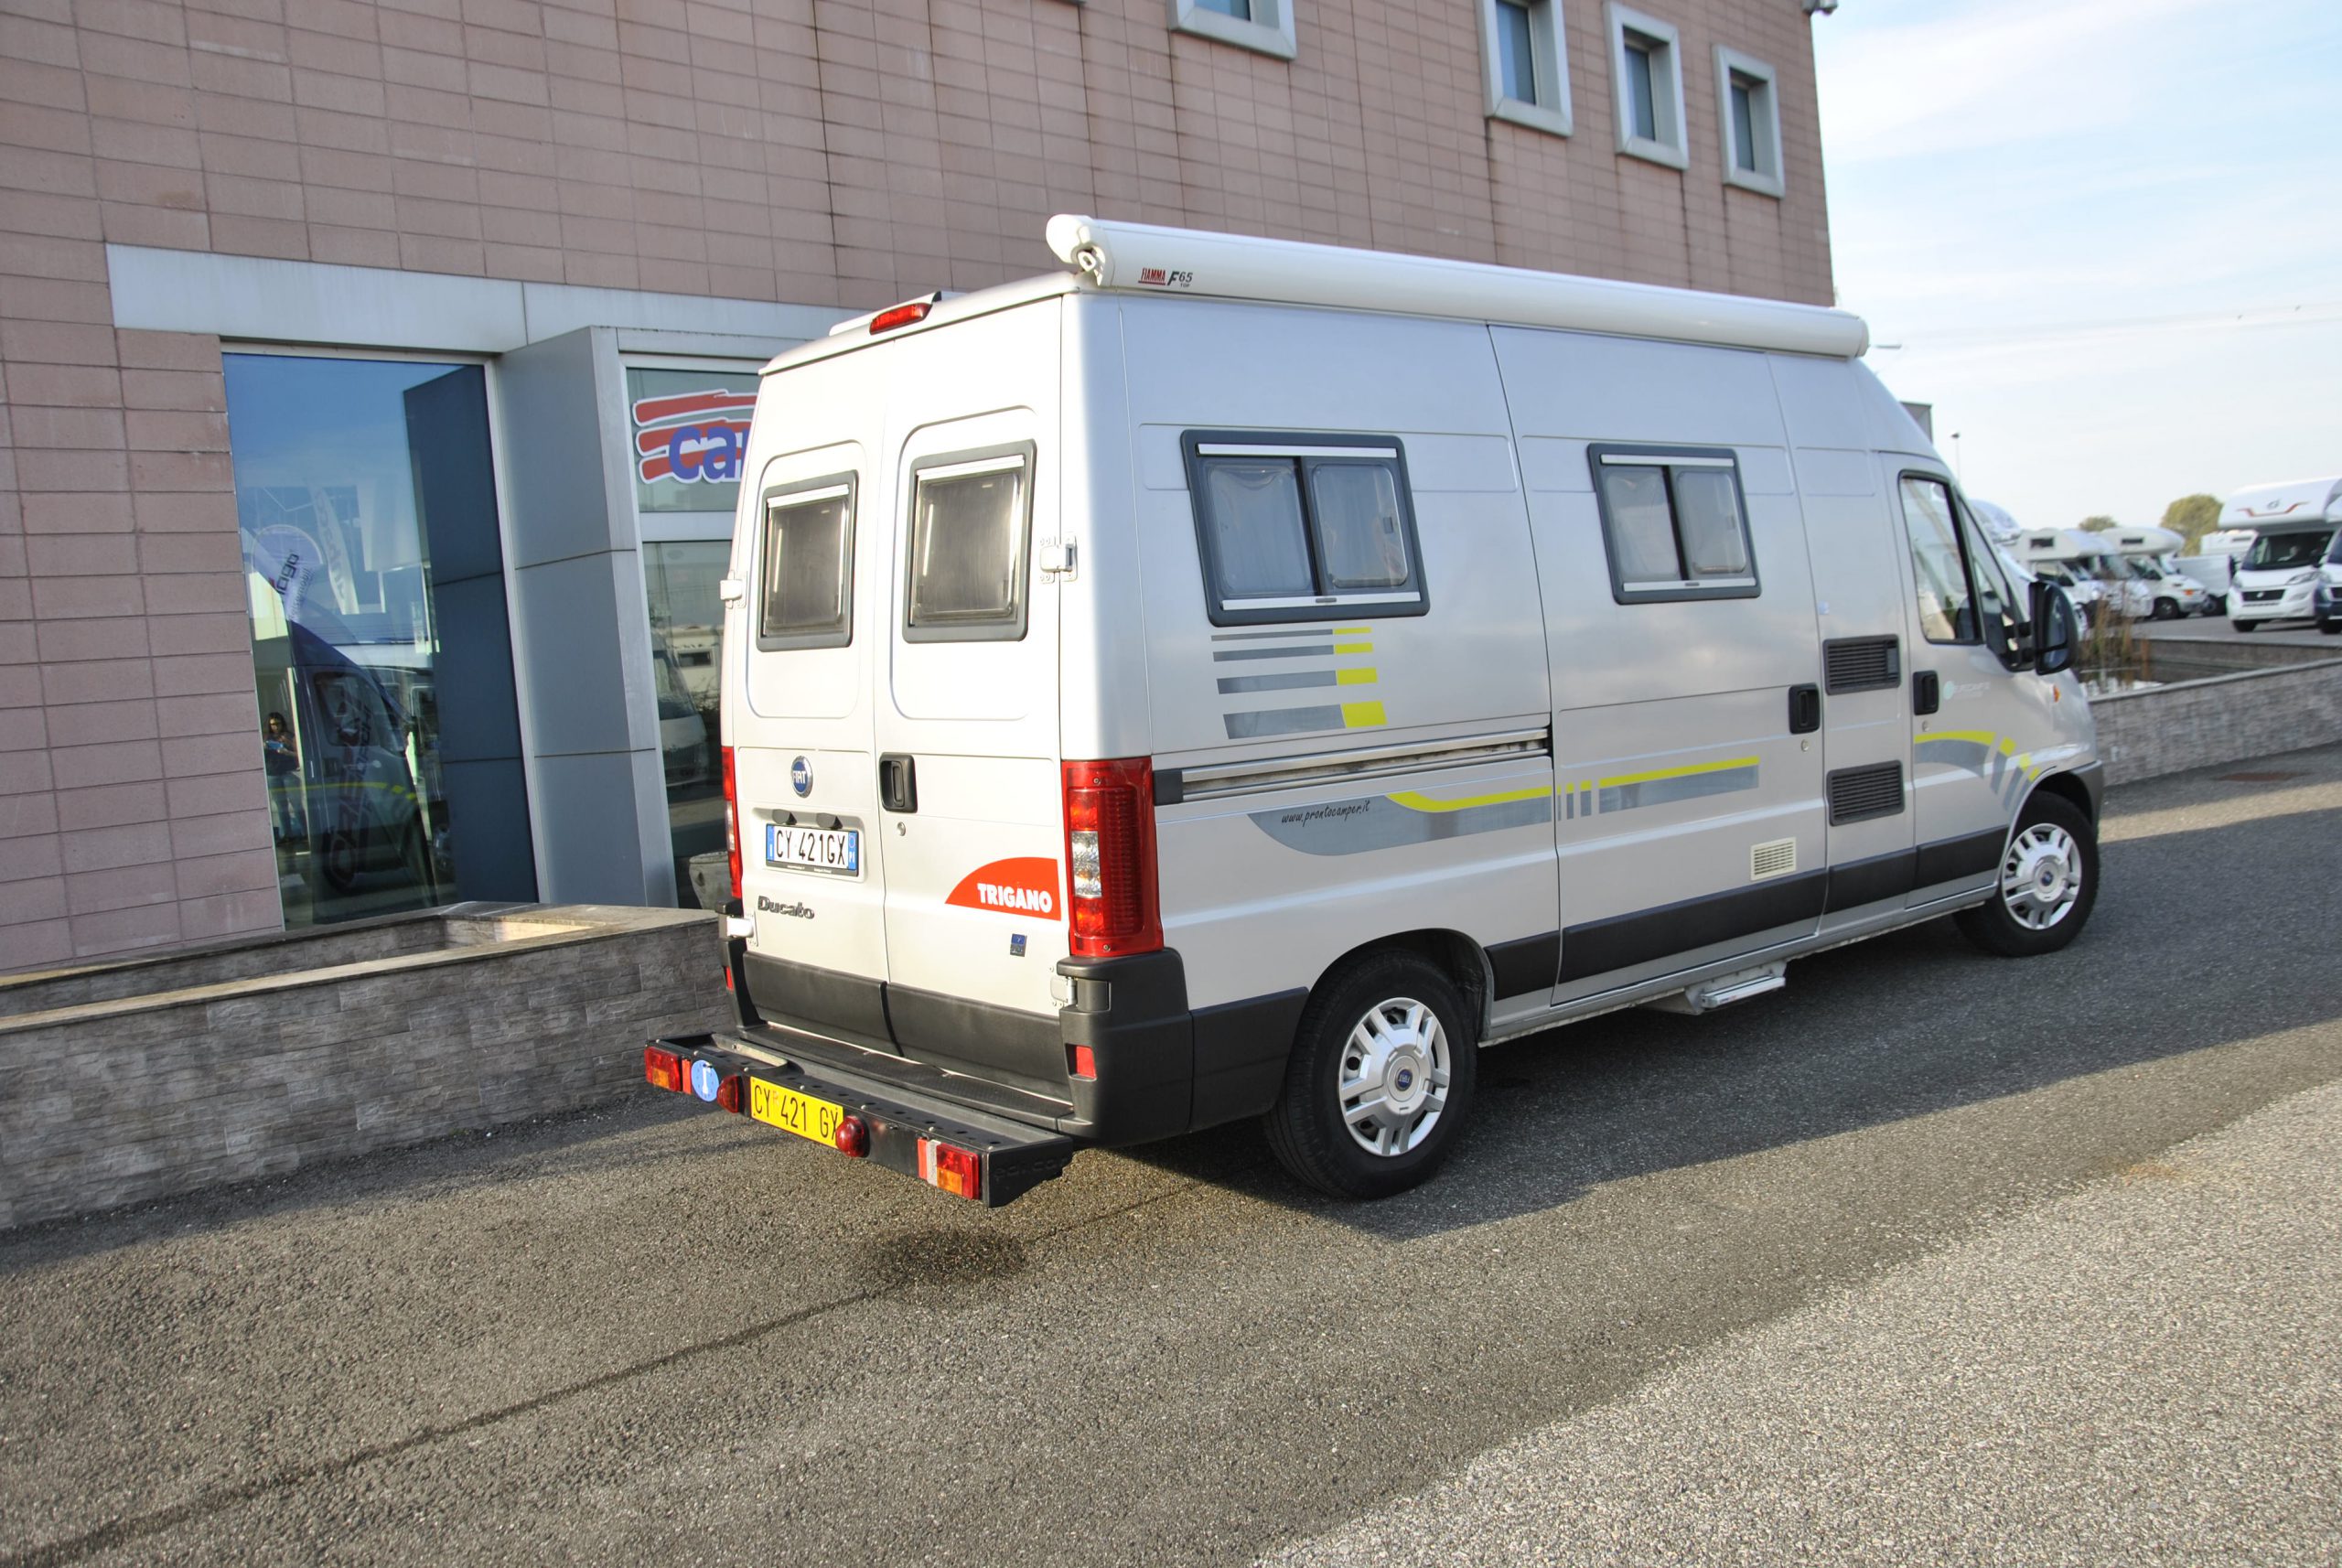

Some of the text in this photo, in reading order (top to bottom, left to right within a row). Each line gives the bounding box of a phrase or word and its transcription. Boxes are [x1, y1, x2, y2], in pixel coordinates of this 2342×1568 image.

[1141, 267, 1193, 285] FIAMMA F65
[793, 770, 806, 784] FIAT
[1282, 800, 1370, 827] www.prontocamper.it
[757, 896, 814, 919] Ducato
[977, 883, 1053, 913] TRIGANO
[755, 1085, 770, 1118] CY
[780, 1095, 806, 1132] 421
